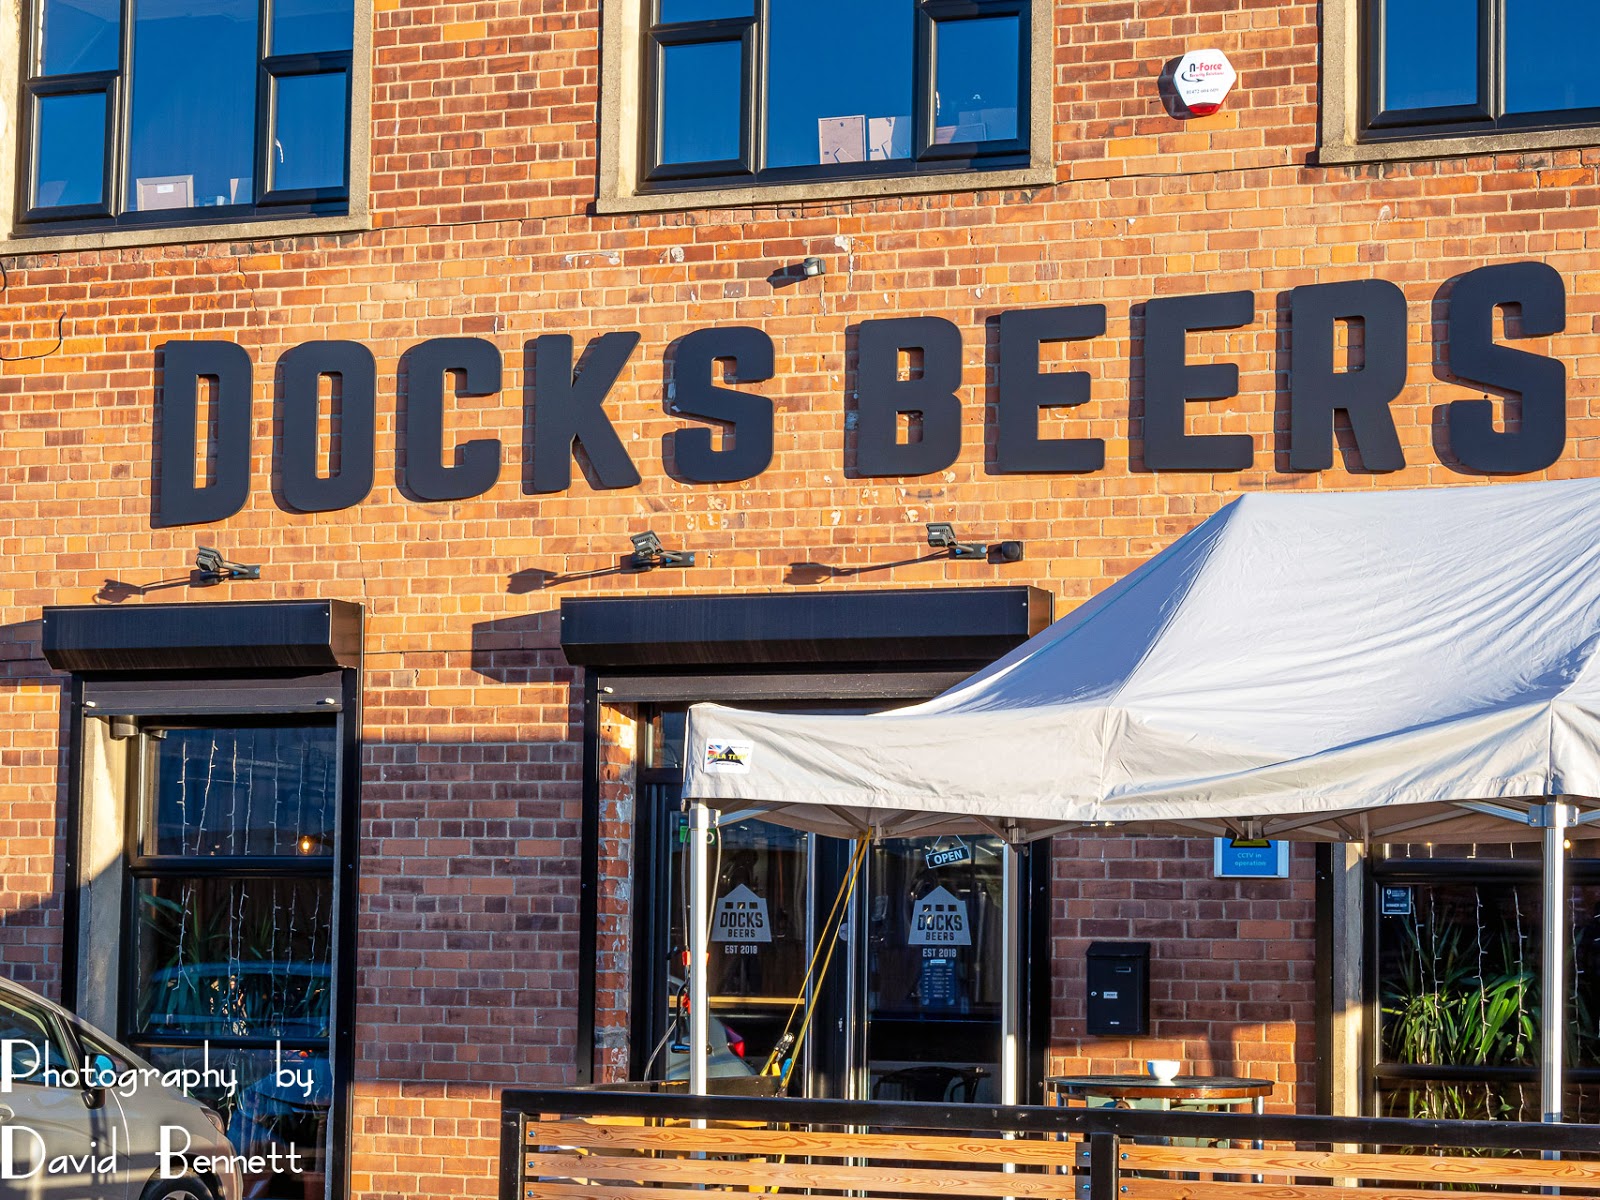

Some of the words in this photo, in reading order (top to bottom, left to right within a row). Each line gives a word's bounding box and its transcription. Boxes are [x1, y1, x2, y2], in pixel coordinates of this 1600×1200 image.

[151, 326, 774, 527] DOCKS
[847, 261, 1566, 477] BEERS
[933, 849, 963, 865] OPEN
[720, 911, 764, 928] DOCKS
[917, 914, 963, 932] DOCKS
[727, 928, 756, 938] BEERS
[925, 931, 955, 941] BEERS
[724, 944, 738, 954] EST
[740, 944, 758, 954] 2018
[922, 948, 936, 958] EST
[938, 948, 957, 958] 2018
